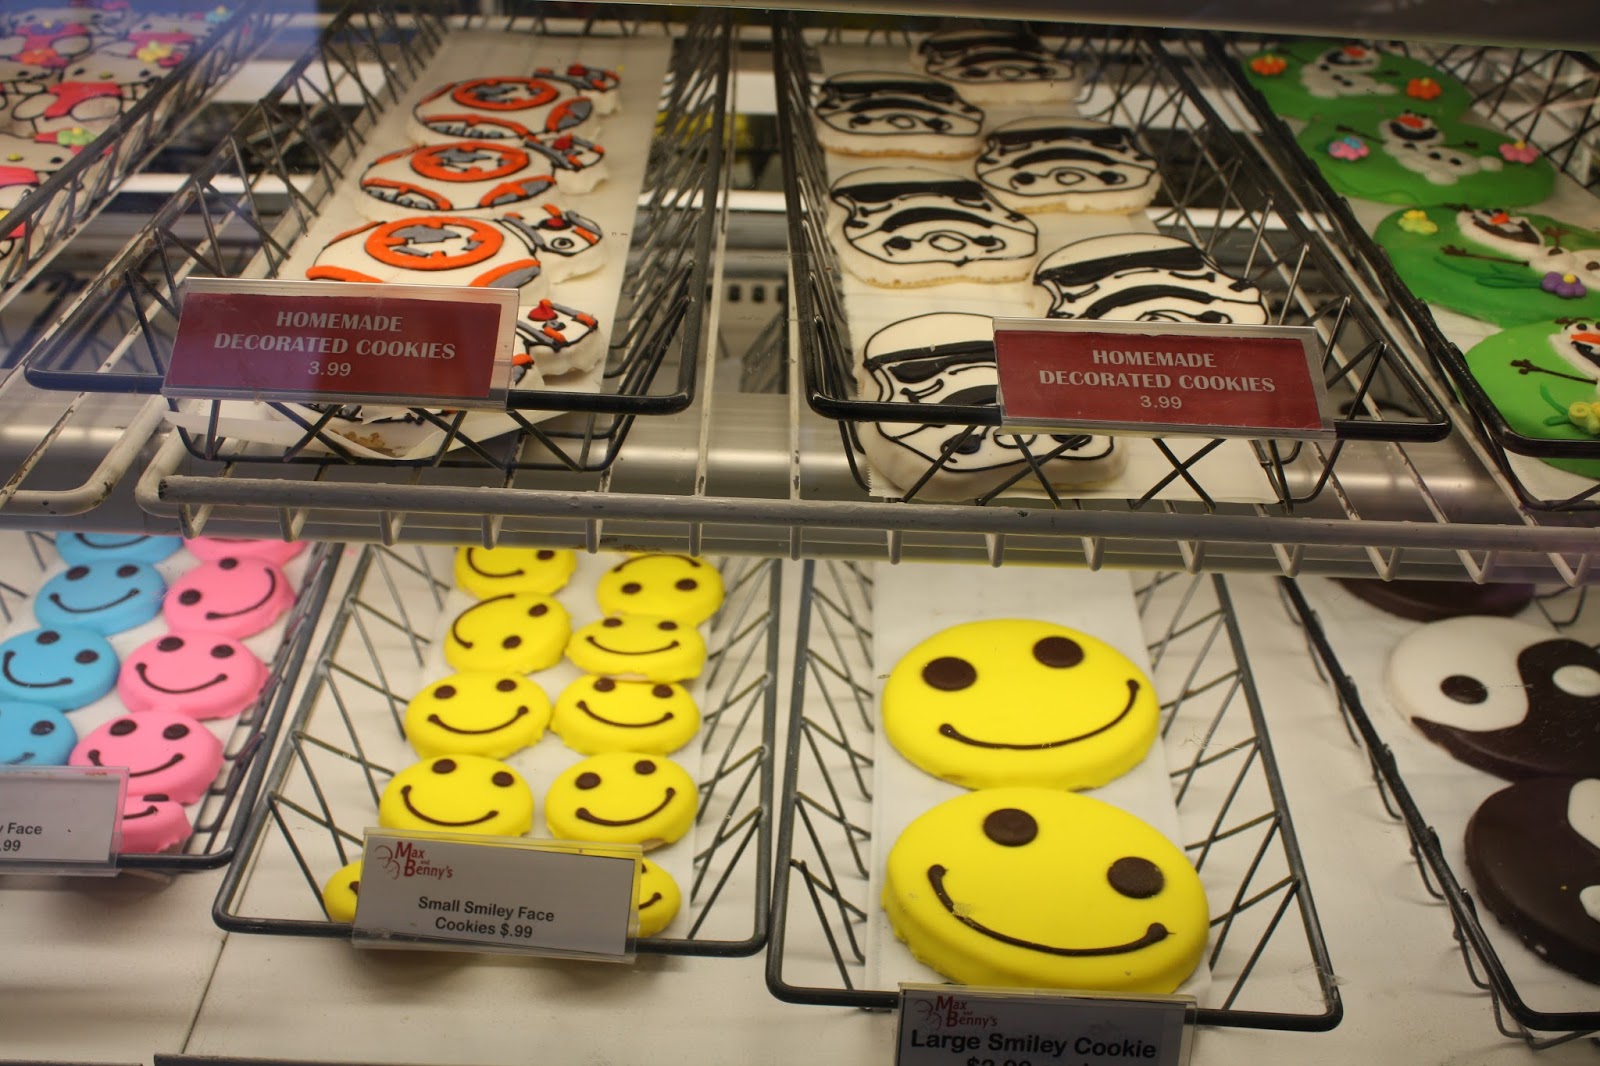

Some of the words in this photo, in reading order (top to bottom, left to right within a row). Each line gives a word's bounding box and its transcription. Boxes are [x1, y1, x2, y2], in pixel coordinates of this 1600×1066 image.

[276, 311, 403, 332] HOMEMADE
[214, 333, 349, 354] DECORATED
[355, 339, 456, 360] COOKIES
[307, 361, 352, 377] 3.99
[1092, 350, 1217, 368] HOMEMADE
[1039, 370, 1172, 389] DECORATED
[1179, 374, 1276, 393] COOKIES
[1140, 395, 1183, 409] 3.99
[7, 822, 43, 835] Face
[395, 841, 425, 859] Max
[404, 859, 453, 880] Benny's
[418, 896, 460, 913] Small
[464, 900, 515, 921] Smiley
[518, 906, 555, 922] Face
[435, 916, 496, 935] Cookies
[500, 923, 533, 939] $.99
[935, 995, 968, 1012] Max
[946, 1010, 998, 1029] Benny's
[911, 1029, 981, 1054] Large
[988, 1033, 1067, 1058] Smiley
[1074, 1037, 1157, 1058] Cookie
